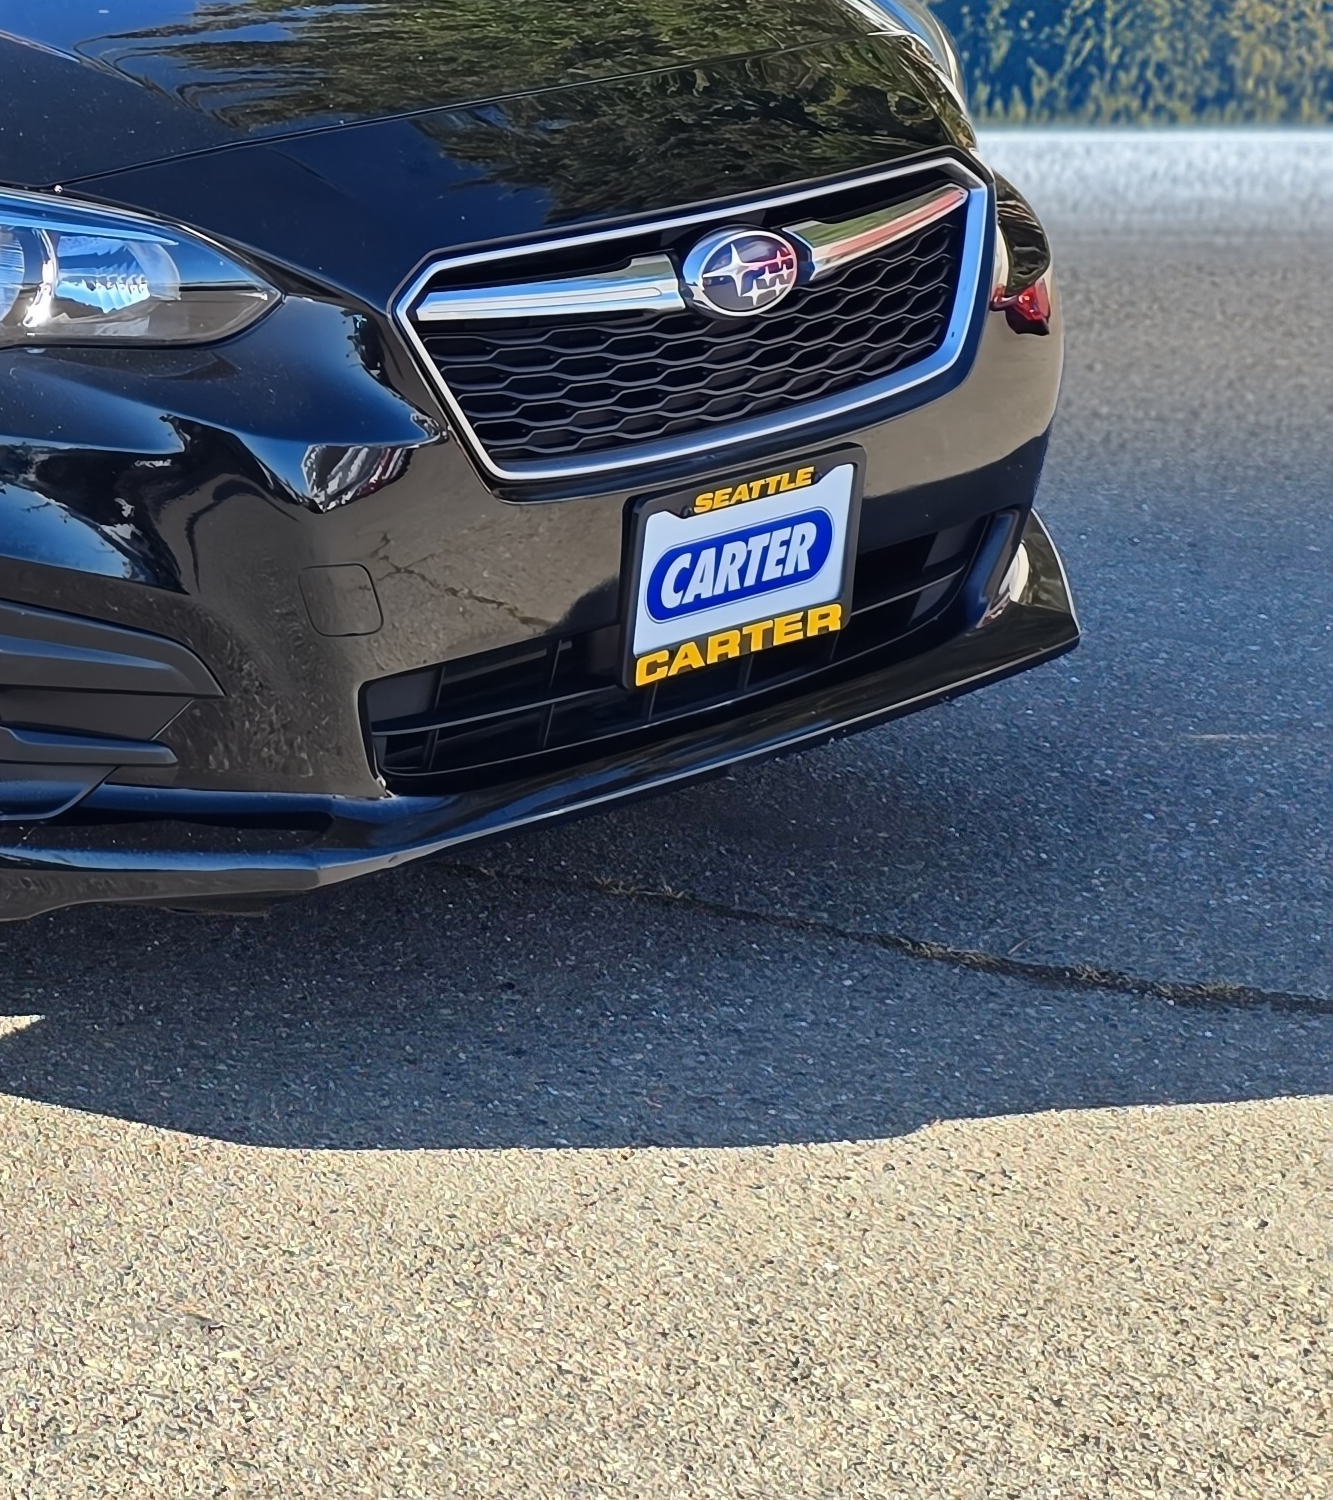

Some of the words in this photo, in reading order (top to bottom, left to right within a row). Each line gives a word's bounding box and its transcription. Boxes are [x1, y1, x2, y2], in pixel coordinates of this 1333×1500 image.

[693, 466, 815, 514] SEATTLE
[660, 521, 818, 610] CARTER
[635, 603, 843, 687] CARTER
